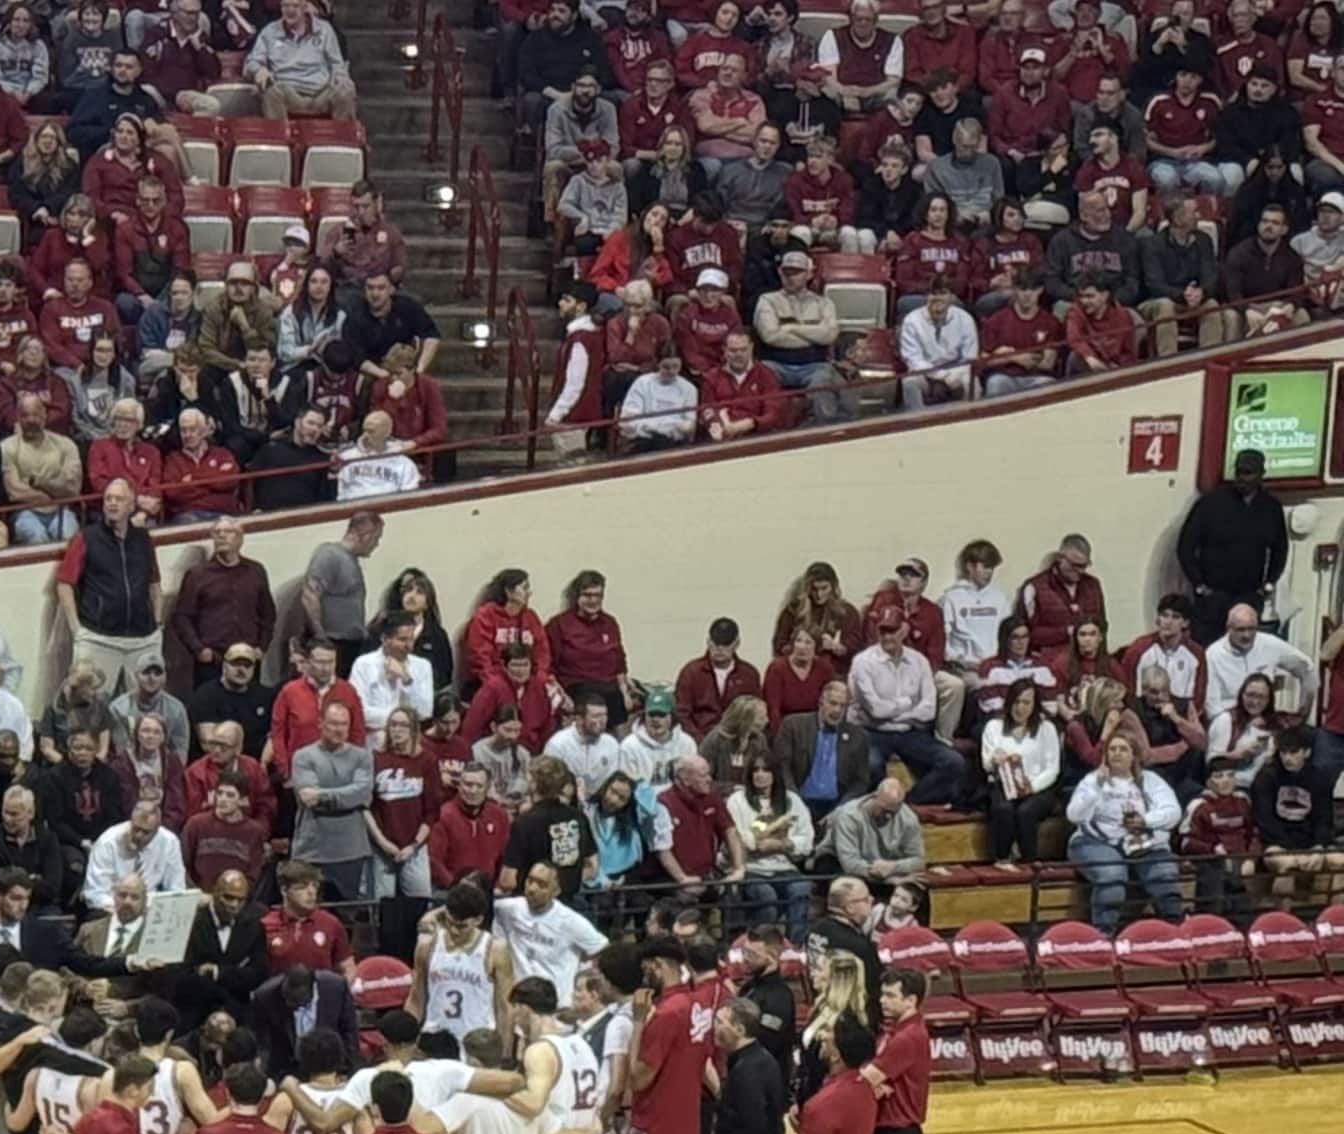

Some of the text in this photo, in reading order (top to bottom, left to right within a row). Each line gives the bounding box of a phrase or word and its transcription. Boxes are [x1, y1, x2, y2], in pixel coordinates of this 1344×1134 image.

[1233, 415, 1299, 432] Greene
[1144, 435, 1164, 467] 4
[444, 990, 463, 1019] 3
[929, 1037, 968, 1059] Vee
[570, 1068, 598, 1111] 12
